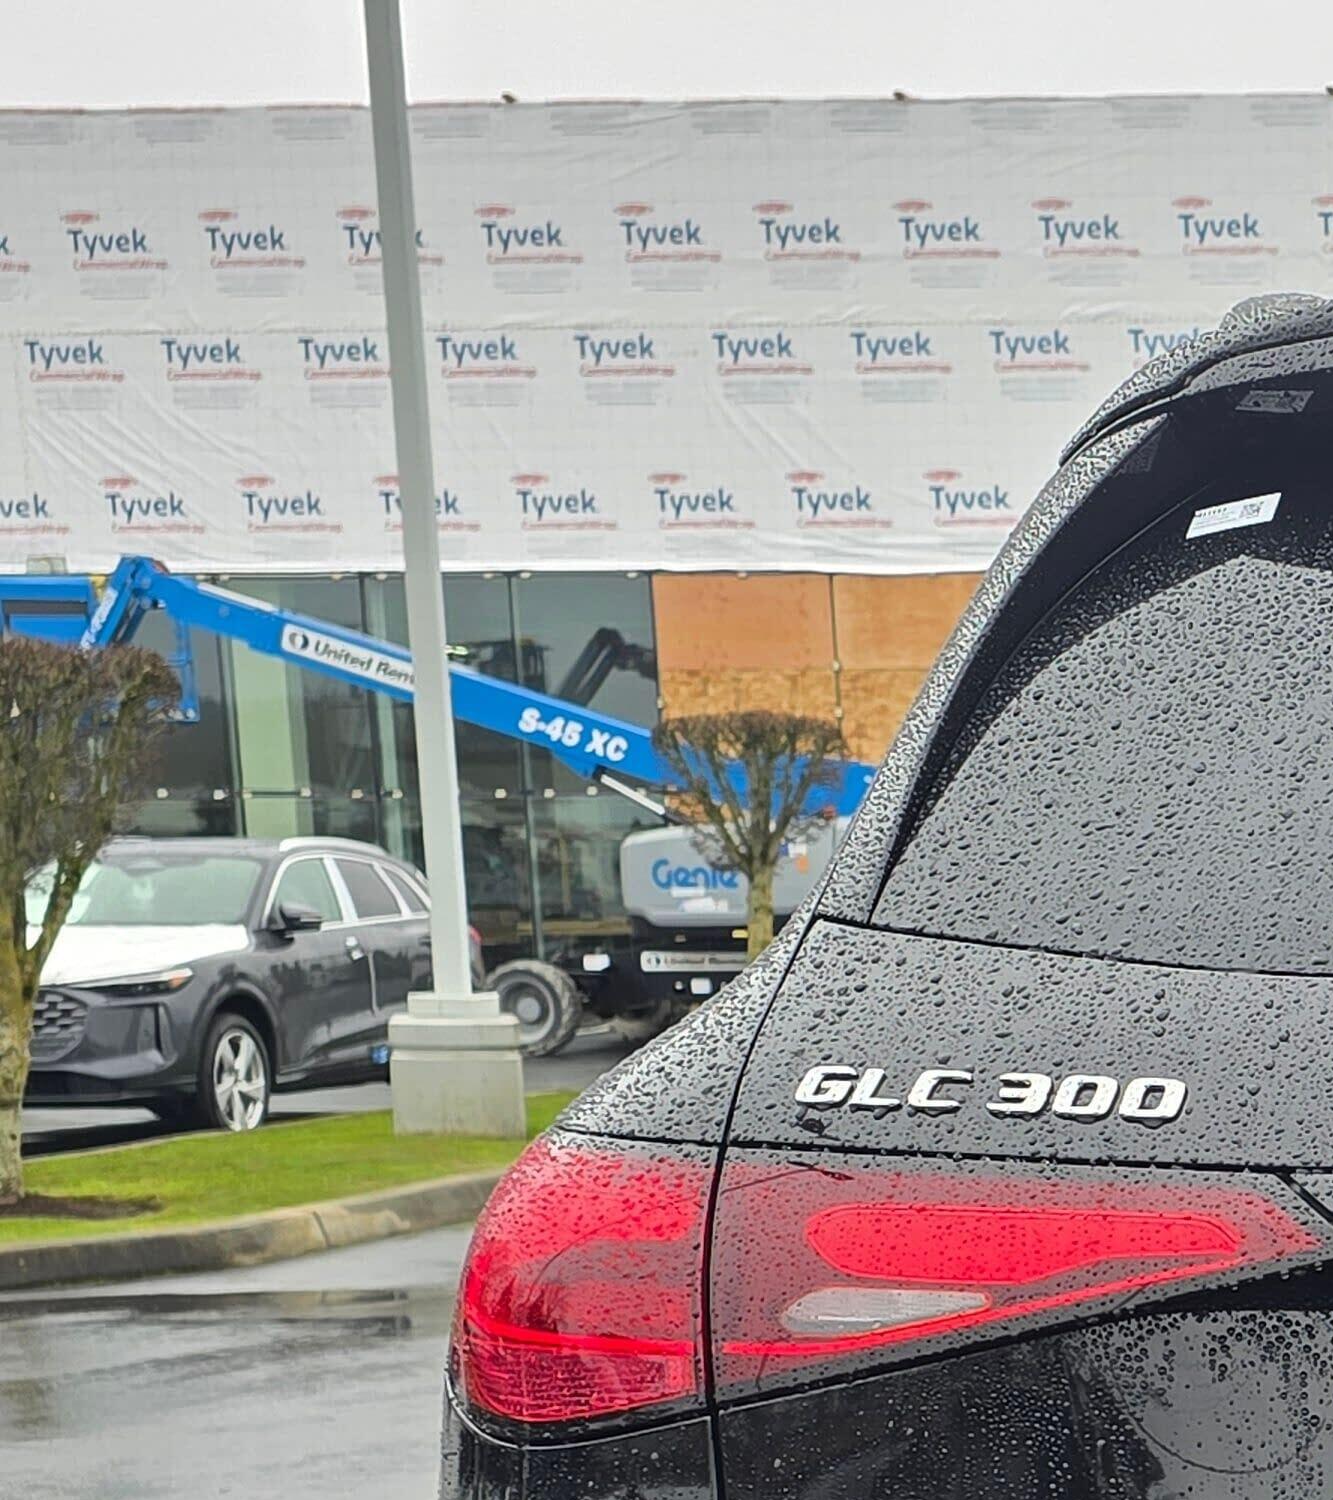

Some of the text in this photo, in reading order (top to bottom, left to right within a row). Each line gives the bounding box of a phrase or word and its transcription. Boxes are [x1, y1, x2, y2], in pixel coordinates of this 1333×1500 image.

[67, 227, 148, 260] Tyvek
[204, 224, 285, 258] Tyvek
[481, 220, 562, 254] Tyvek
[619, 218, 702, 252] Tyvek
[759, 217, 841, 250] Tyvek
[897, 215, 980, 248] Tyvek
[1037, 214, 1120, 247] Tyvek
[1177, 212, 1260, 244] Tyvek
[23, 338, 104, 371] Tyvek
[160, 337, 241, 370] Tyvek
[298, 336, 379, 369] Tyvek
[436, 334, 517, 367] Tyvek
[573, 333, 655, 366] Tyvek
[712, 331, 794, 364] Tyvek
[850, 330, 931, 363] Tyvek
[988, 329, 1070, 362] Tyvek
[105, 491, 186, 524] Tyvek
[242, 490, 322, 523] Tyvek
[518, 488, 598, 521] Tyvek
[655, 487, 735, 520] Tyvek
[792, 486, 872, 519] Tyvek
[929, 485, 1010, 518] Tyvek
[314, 639, 374, 672] United
[518, 706, 629, 763] S-45 XC
[652, 858, 739, 890] Genie
[795, 1065, 1187, 1119] GLC 300
